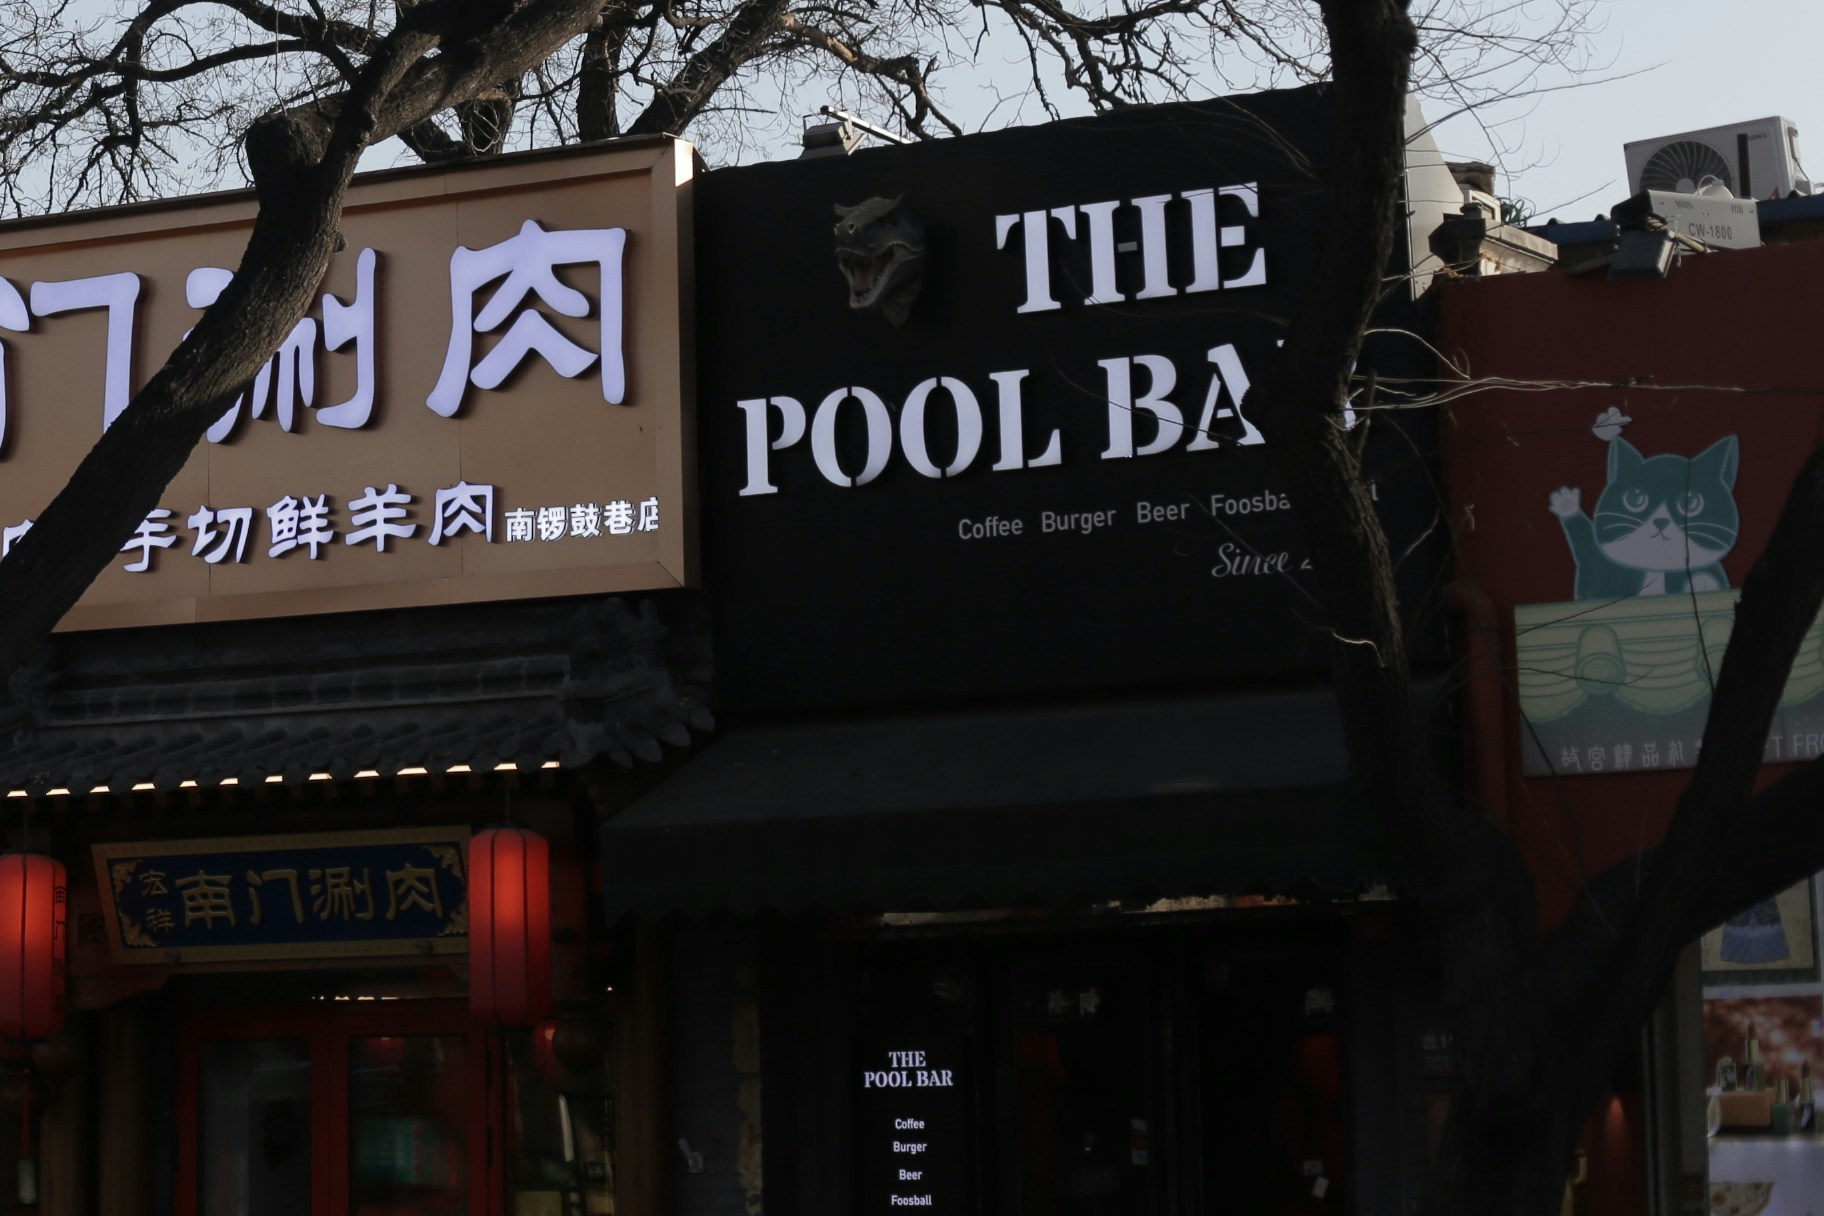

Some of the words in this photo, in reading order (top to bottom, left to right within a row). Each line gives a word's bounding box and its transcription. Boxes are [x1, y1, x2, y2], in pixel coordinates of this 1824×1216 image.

[1687, 222, 1733, 241] CW-1800
[995, 181, 1268, 314] THE
[736, 368, 1064, 497] POOL
[1096, 341, 1286, 461] BA
[504, 496, 660, 543] 南锣鼓巷店
[957, 514, 1024, 541] Coffee
[1040, 506, 1117, 536] Burger
[1136, 499, 1191, 524] Beer
[1210, 488, 1293, 518] Foosba
[1210, 541, 1291, 579] Since
[1560, 740, 1702, 772] 故宫精品礼
[174, 860, 444, 932] 南门涮肉
[888, 1049, 927, 1069] THE
[863, 1071, 913, 1089] POOL
[915, 1069, 954, 1087] BAR
[894, 1117, 926, 1131] Coffee
[892, 1140, 928, 1155] Burger
[898, 1168, 924, 1181] Beer
[890, 1194, 933, 1207] Foosball
